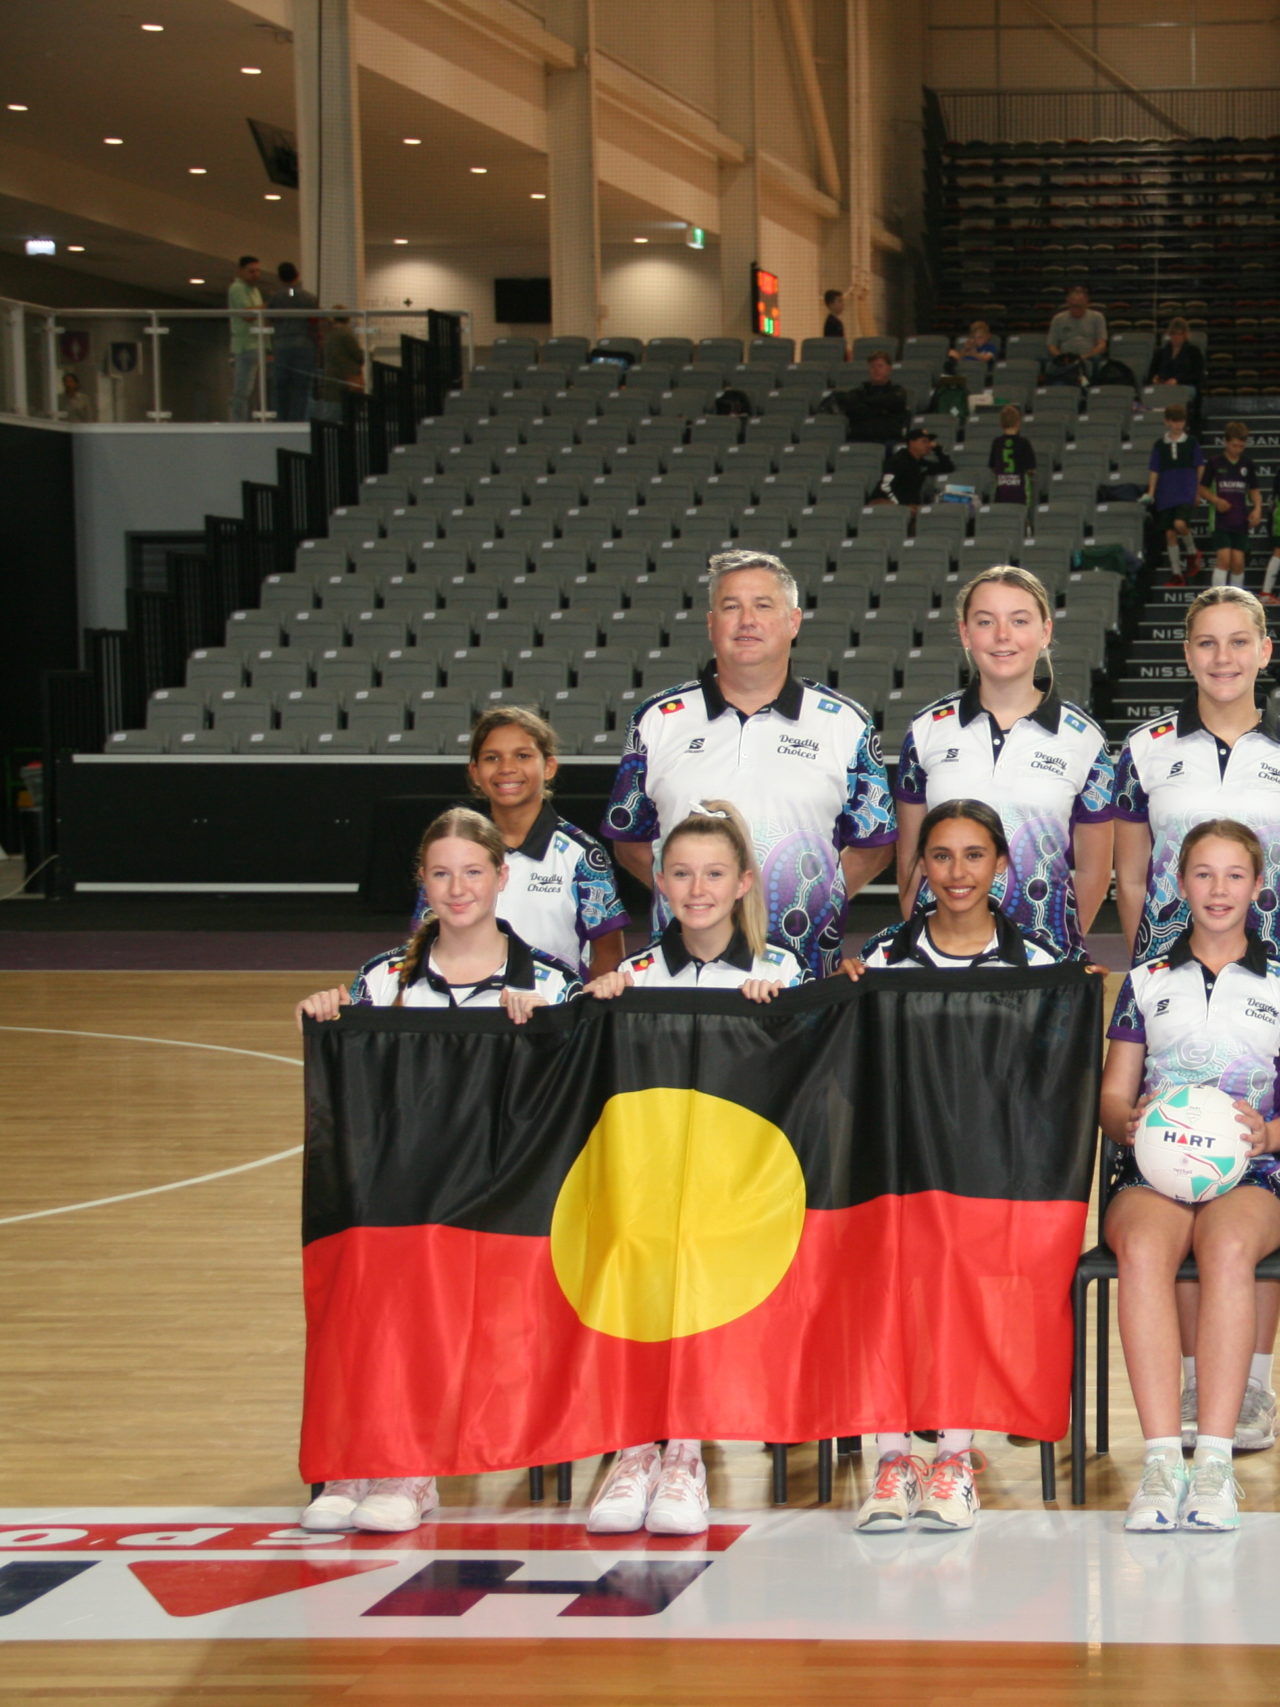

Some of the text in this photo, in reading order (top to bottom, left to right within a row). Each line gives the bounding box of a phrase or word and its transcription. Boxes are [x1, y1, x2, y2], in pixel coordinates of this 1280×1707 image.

[1214, 435, 1280, 446] NSAN
[1152, 628, 1185, 639] NIS
[1140, 666, 1188, 677] NISS
[1127, 705, 1176, 717] NISS
[779, 734, 820, 751] Deadly
[776, 745, 817, 760] Choices
[1034, 751, 1068, 770] Deadly
[1030, 760, 1064, 776] Choices
[530, 872, 563, 883] Deadly
[527, 883, 561, 893] Choices
[1244, 1007, 1276, 1025] Choices
[1163, 1130, 1217, 1149] HART
